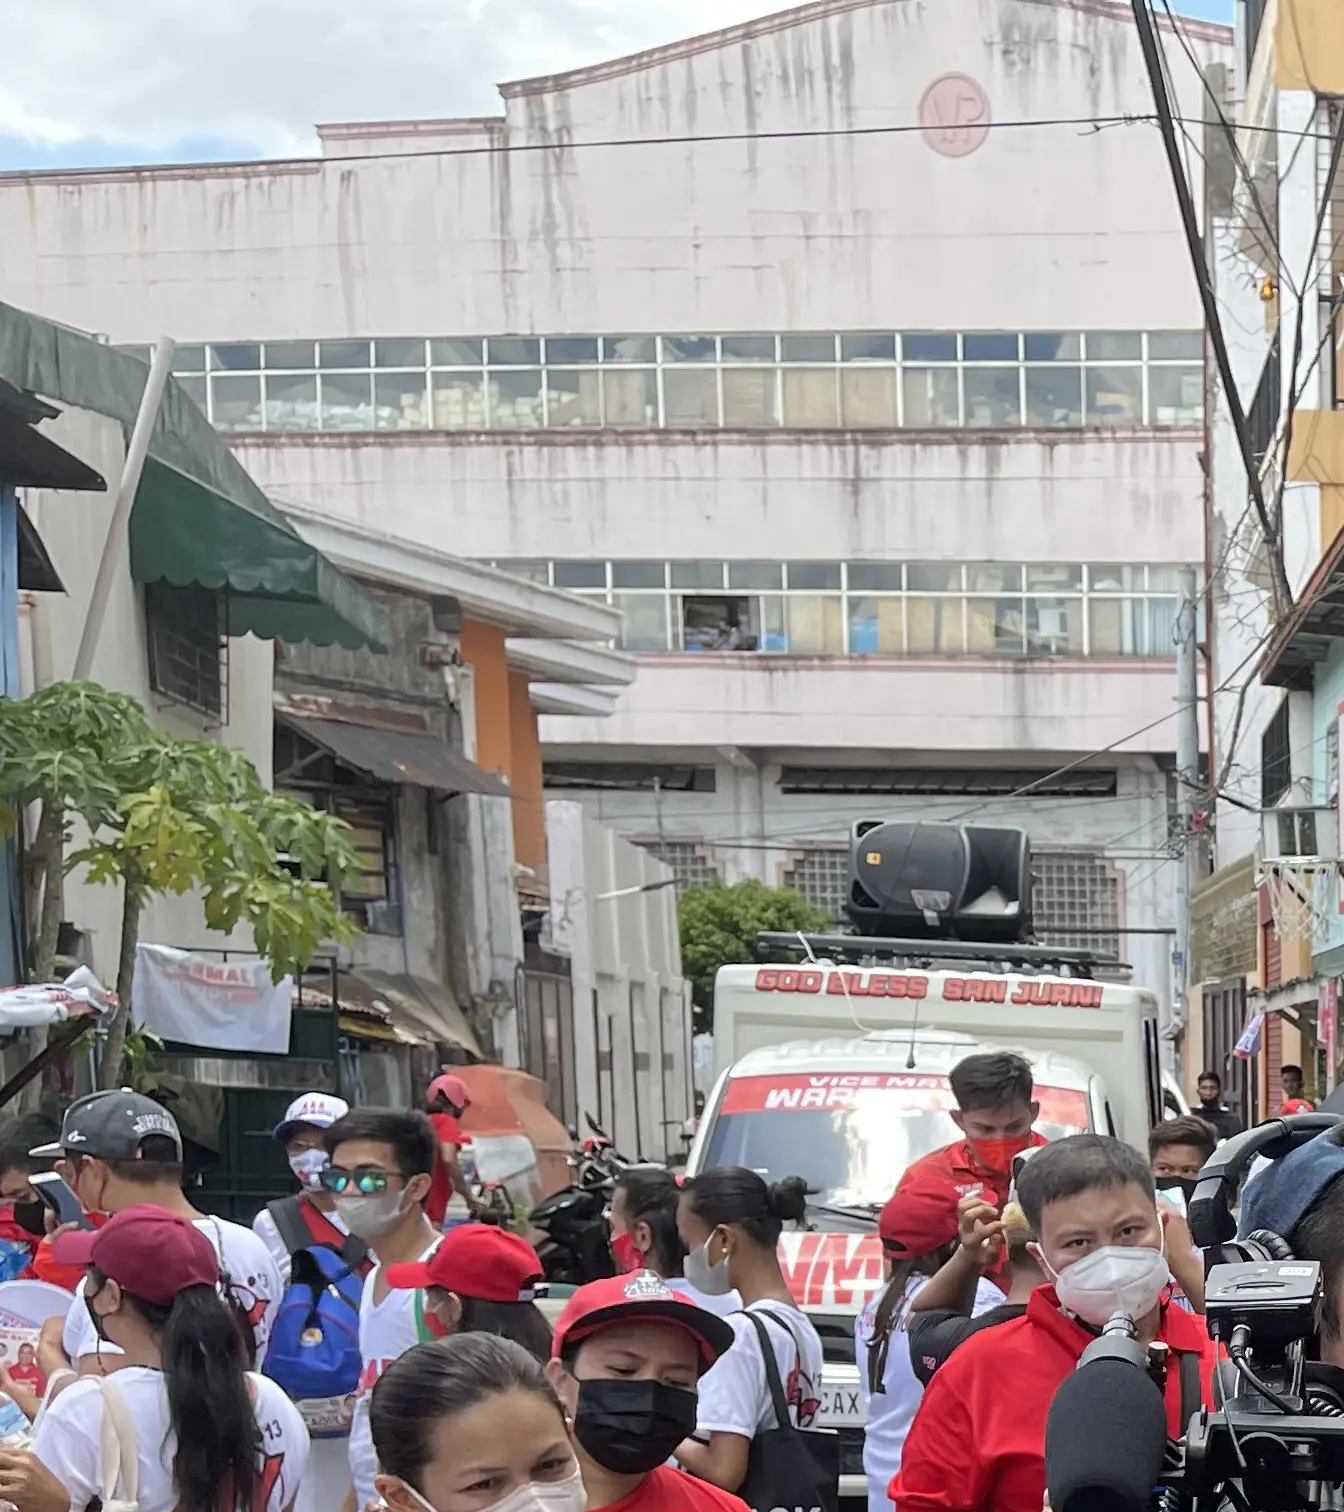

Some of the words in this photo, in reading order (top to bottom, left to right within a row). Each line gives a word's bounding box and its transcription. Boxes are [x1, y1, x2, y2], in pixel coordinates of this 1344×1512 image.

[755, 969, 823, 993] GOD
[826, 971, 929, 999] BLESS
[942, 978, 1006, 1004] SAN
[1011, 982, 1104, 1009] JUAN!
[808, 1076, 884, 1088] VICE
